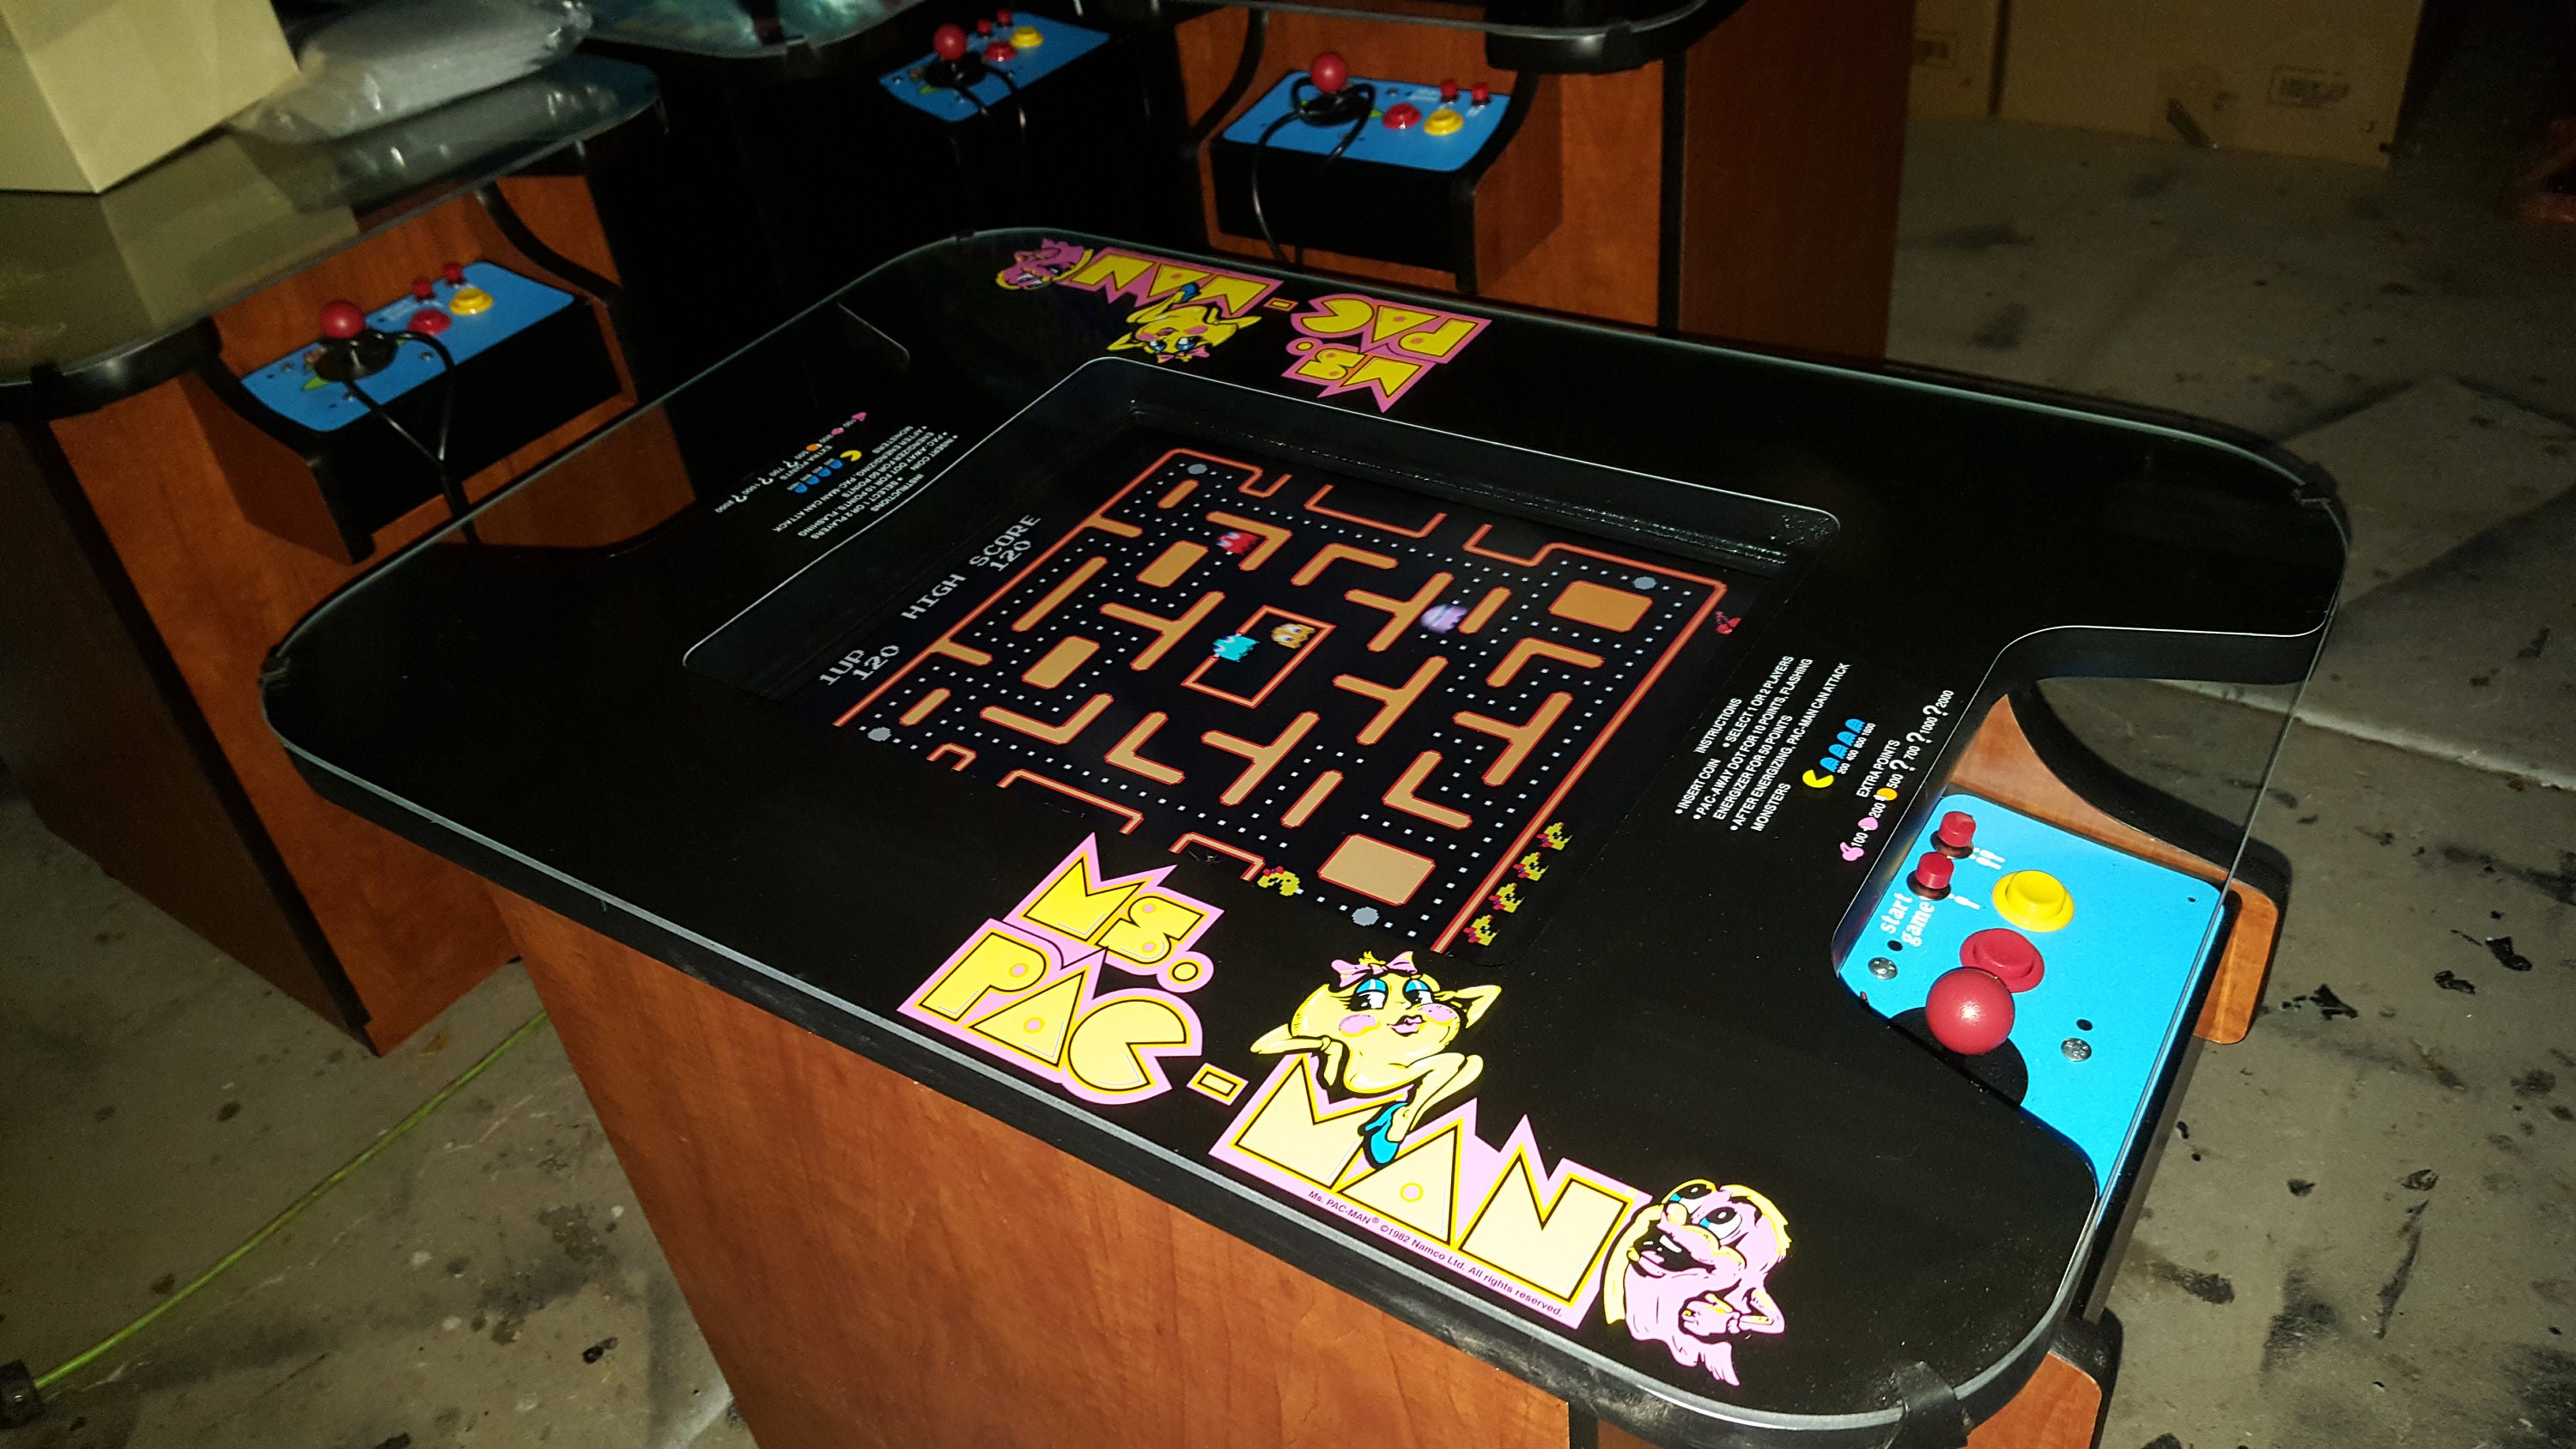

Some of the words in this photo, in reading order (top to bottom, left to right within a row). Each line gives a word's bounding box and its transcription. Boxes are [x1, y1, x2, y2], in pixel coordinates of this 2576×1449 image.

[872, 426, 914, 454] MONSTERS
[894, 432, 934, 462] ENERGIZER
[899, 428, 924, 446] AFTER
[906, 434, 944, 464] PAC-AWAY
[928, 438, 956, 458] INSERT
[806, 445, 833, 462] EXTRA
[853, 445, 902, 477] ENERGIZING,
[878, 459, 896, 473] FOR
[910, 456, 931, 471] COIN
[779, 460, 809, 481] POINTS
[874, 473, 893, 487] FOR
[892, 462, 908, 476] DOT
[820, 476, 857, 502] PAC-MAN
[841, 477, 872, 499] POINTS
[868, 481, 899, 502] SELECT
[870, 474, 925, 512] INSTRUCTIONS
[803, 500, 823, 512] CAN
[854, 504, 866, 514] OR
[773, 511, 805, 532] ATTACK
[798, 510, 839, 537] FLASHING
[811, 515, 848, 539] PLAYERS
[901, 573, 967, 620] HIGH
[969, 514, 1042, 567] SCORE
[989, 540, 1031, 572] 120
[819, 649, 866, 686] 1UP
[853, 645, 900, 681] 120
[1764, 656, 1795, 689] PLAYERS
[1751, 694, 1765, 707] OR
[1760, 687, 1771, 696] 2
[1694, 698, 1742, 754] INSTRUCTIONS
[1696, 769, 1735, 815] PAC-AWAY
[1727, 752, 1747, 771] DOT
[1741, 734, 1760, 753] FOR
[1753, 723, 1767, 737] 10
[1760, 696, 1789, 726] POINTS,
[1779, 658, 1814, 695] FLASHING
[1728, 711, 1753, 743] SELECT
[1765, 714, 1793, 745] POINTS
[1732, 796, 1759, 827] AFTER
[1753, 746, 1796, 798] ENERGIZING,
[1786, 708, 1820, 745] PAC-MAN
[1810, 692, 1830, 709] CAN
[1824, 663, 1851, 693] ATTACK
[1759, 744, 1773, 756] 50
[1837, 762, 1850, 775] 200
[1846, 749, 1859, 761] 400
[1854, 737, 1868, 749] 800
[1862, 723, 1876, 737] 1600
[1746, 754, 1766, 773] FOR
[1851, 832, 1868, 847] 100
[1868, 802, 1886, 819] 200
[1886, 773, 1904, 789] 500
[1903, 745, 1921, 761] 700
[1919, 716, 1938, 735] 1000
[1935, 689, 1954, 709] 2000
[1856, 768, 1882, 798] EXTRA
[1873, 739, 1901, 771] POINTS
[1677, 778, 1705, 809] INSERT
[1698, 758, 1722, 780] COIN
[1712, 772, 1754, 821] ENERGIZER
[1750, 782, 1791, 832] MONSTERS
[1880, 892, 1913, 934] start
[1901, 901, 1935, 948] game
[1308, 1190, 1325, 1203] Ms.
[1411, 1239, 1446, 1261] Namco
[1447, 1256, 1466, 1272] Ltd.
[1467, 1266, 1483, 1278] All
[1484, 1273, 1513, 1294] rights
[1515, 1288, 1563, 1318] reserved.
